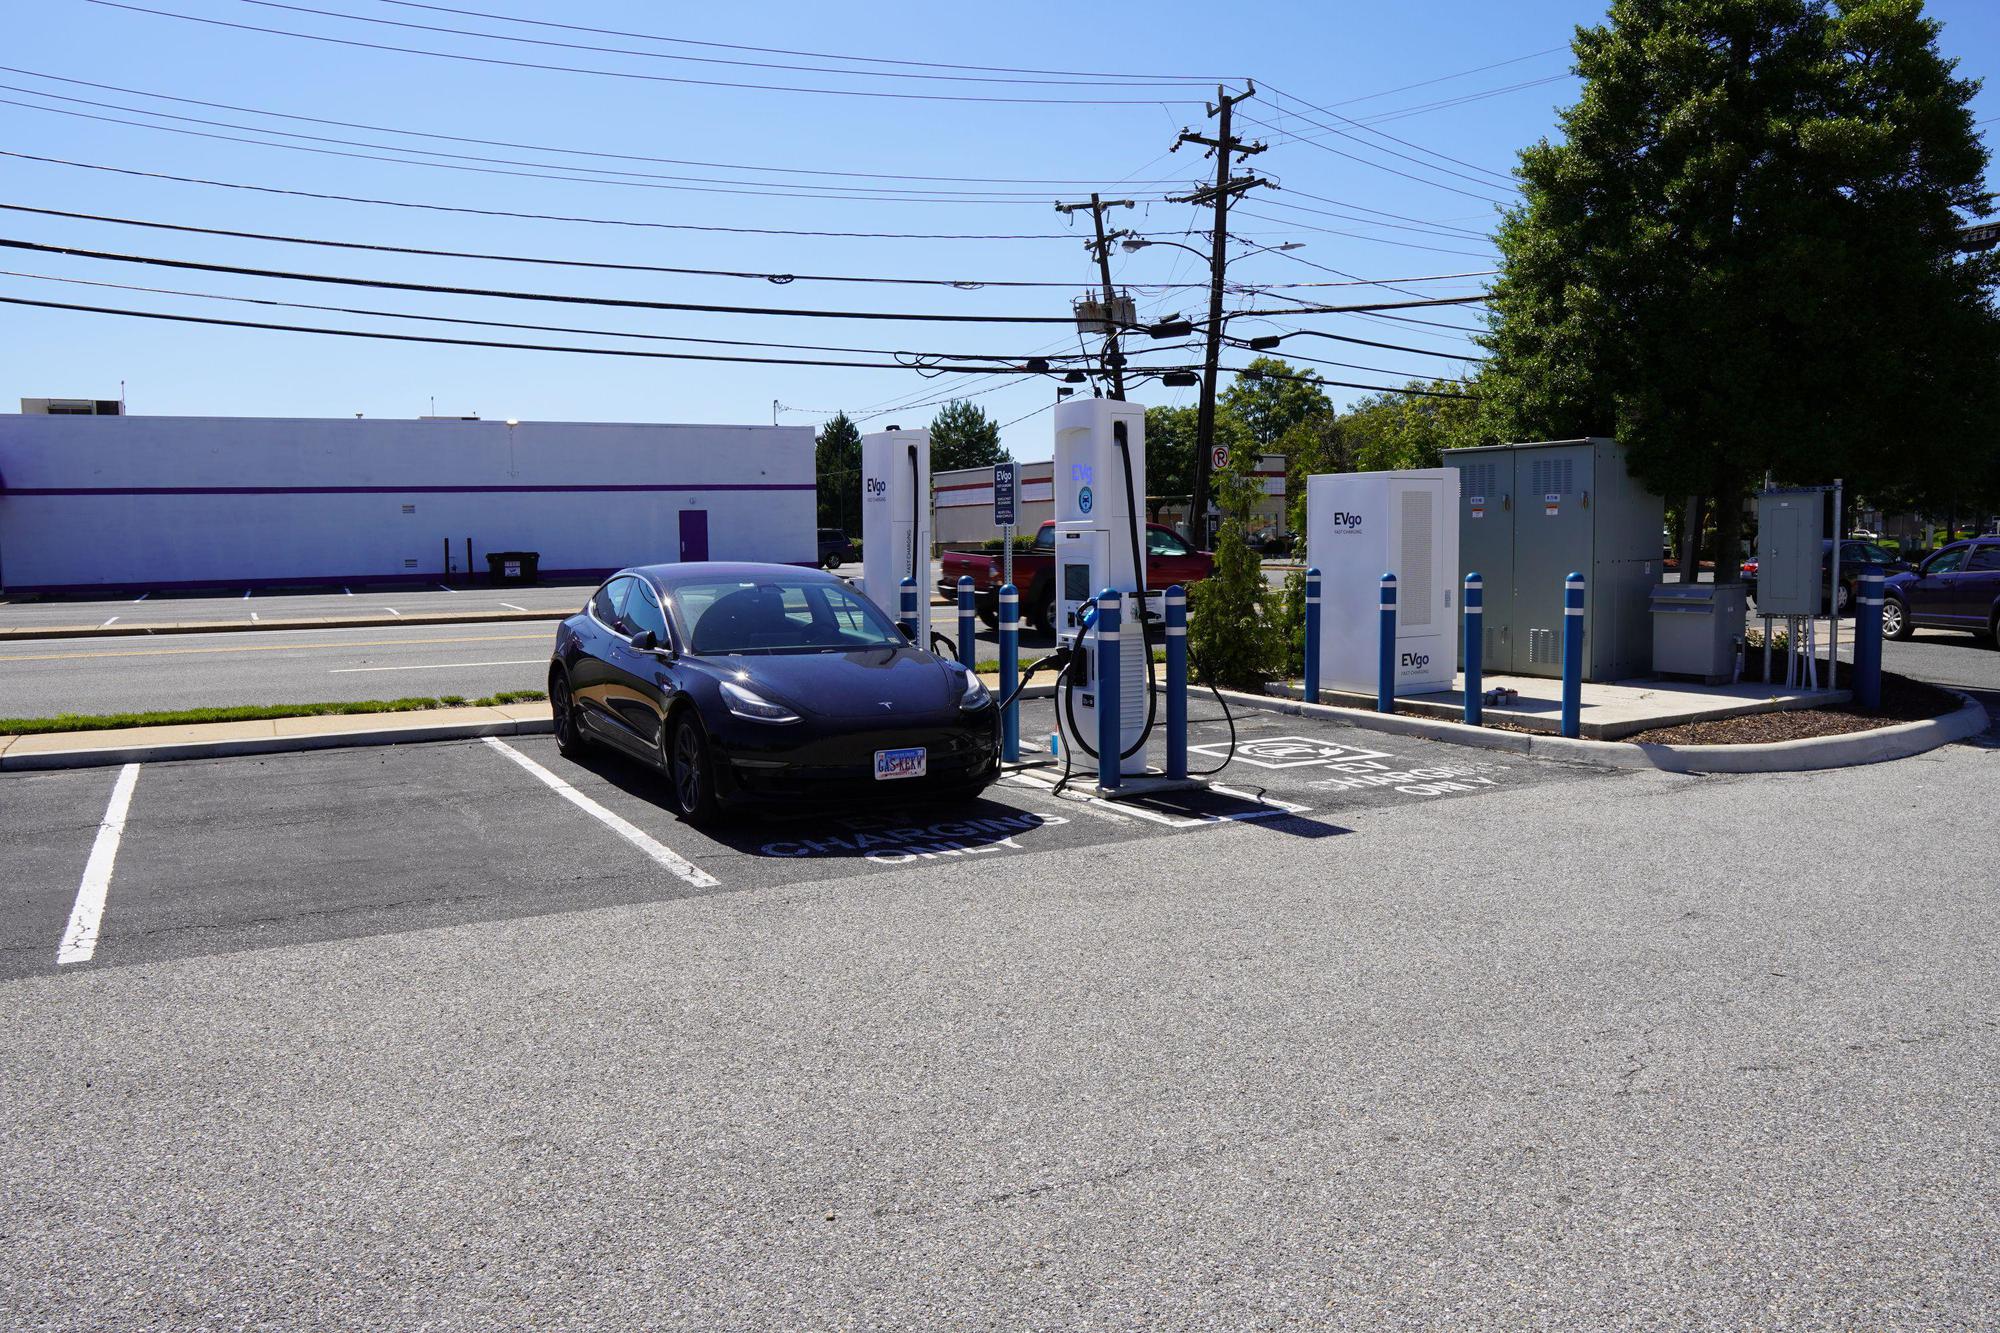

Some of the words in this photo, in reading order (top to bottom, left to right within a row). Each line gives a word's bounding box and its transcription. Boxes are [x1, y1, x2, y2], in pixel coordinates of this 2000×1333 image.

[996, 470, 1012, 483] EVgo
[867, 478, 886, 496] EVgo
[1334, 512, 1362, 529] EVgo
[1401, 653, 1430, 669] EVgo
[1324, 761, 1391, 773] EV
[760, 812, 1071, 858] CHARGING
[863, 836, 1023, 864] ONLY
